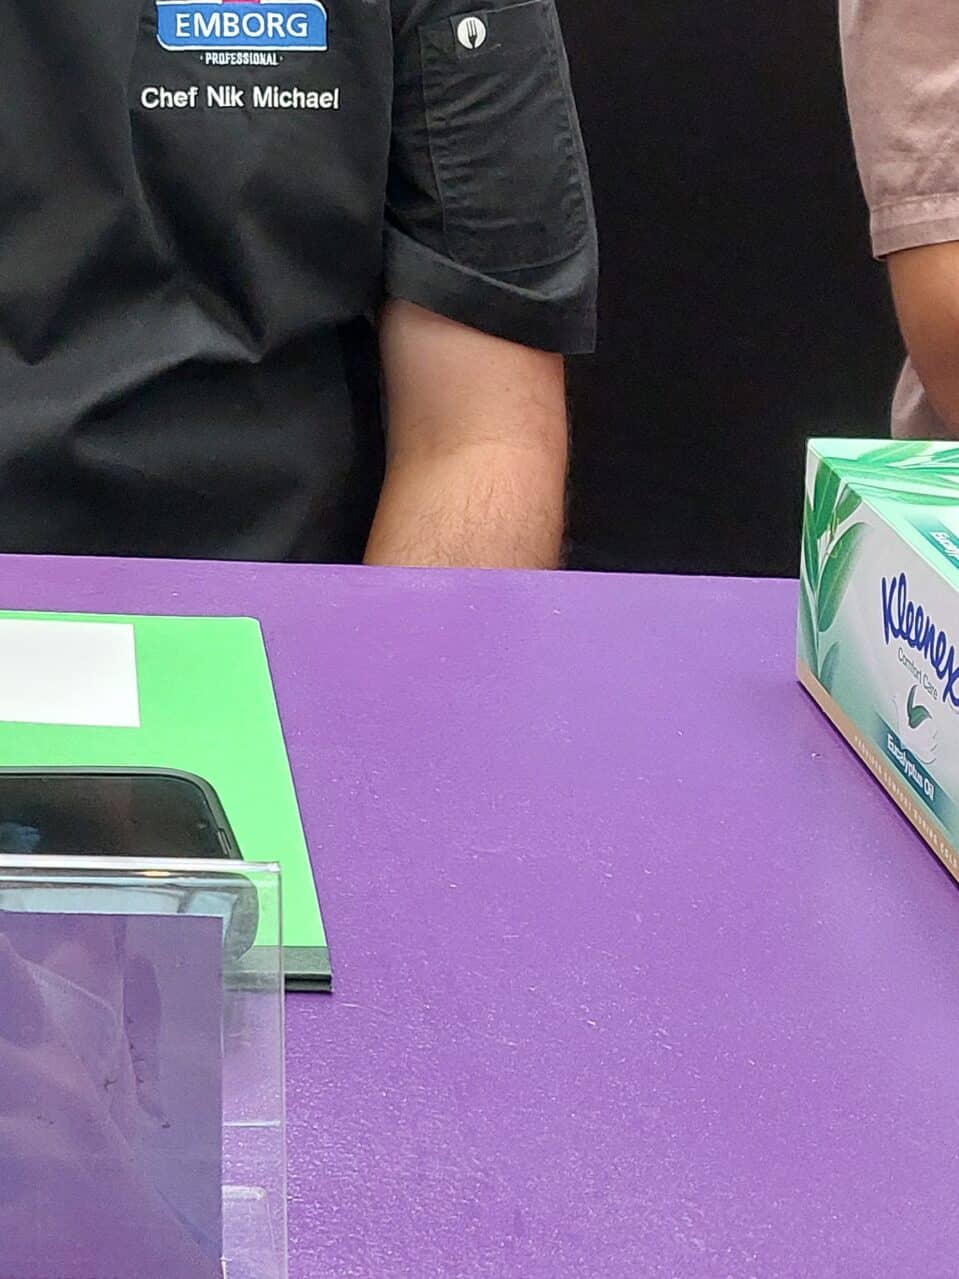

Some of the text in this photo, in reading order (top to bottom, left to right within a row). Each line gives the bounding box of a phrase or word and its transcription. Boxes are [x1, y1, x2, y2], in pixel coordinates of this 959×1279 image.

[175, 11, 309, 39] EMBORG
[204, 51, 280, 67] PROFESSIONAL
[140, 85, 339, 110] Chef Nik Michael
